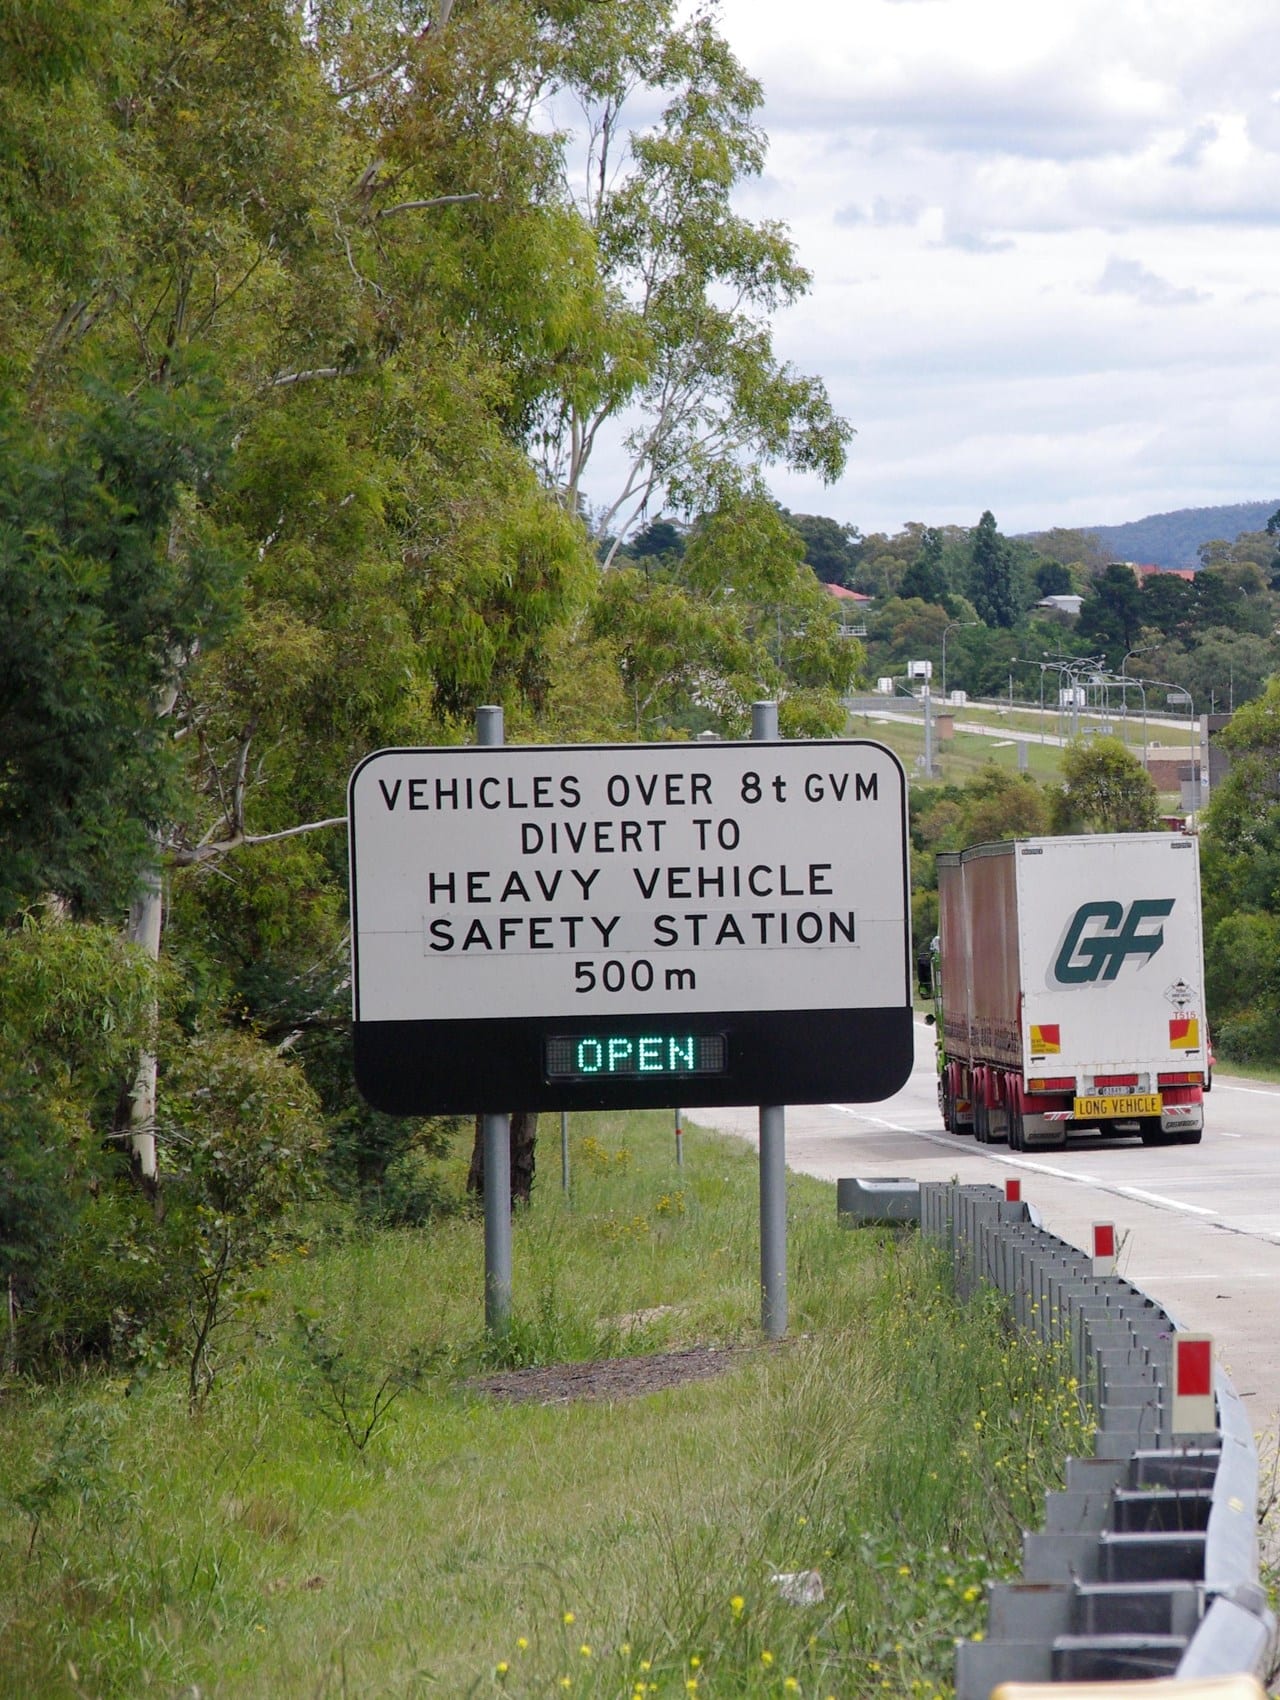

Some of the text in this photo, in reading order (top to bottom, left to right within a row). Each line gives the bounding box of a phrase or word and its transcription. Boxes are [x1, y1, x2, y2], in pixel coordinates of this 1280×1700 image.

[379, 776, 580, 810] VEHICLES
[608, 774, 712, 806] OVER
[805, 773, 877, 803] GVM
[522, 819, 740, 855] DIVERT TO
[428, 864, 833, 904] HEAVY VEHICLE
[429, 911, 855, 951] SAFETY STATION
[1054, 898, 1176, 984] GF
[575, 960, 696, 993] 500m
[577, 1036, 695, 1072] OPEN
[1080, 1097, 1158, 1115] LONG VEHICLE
